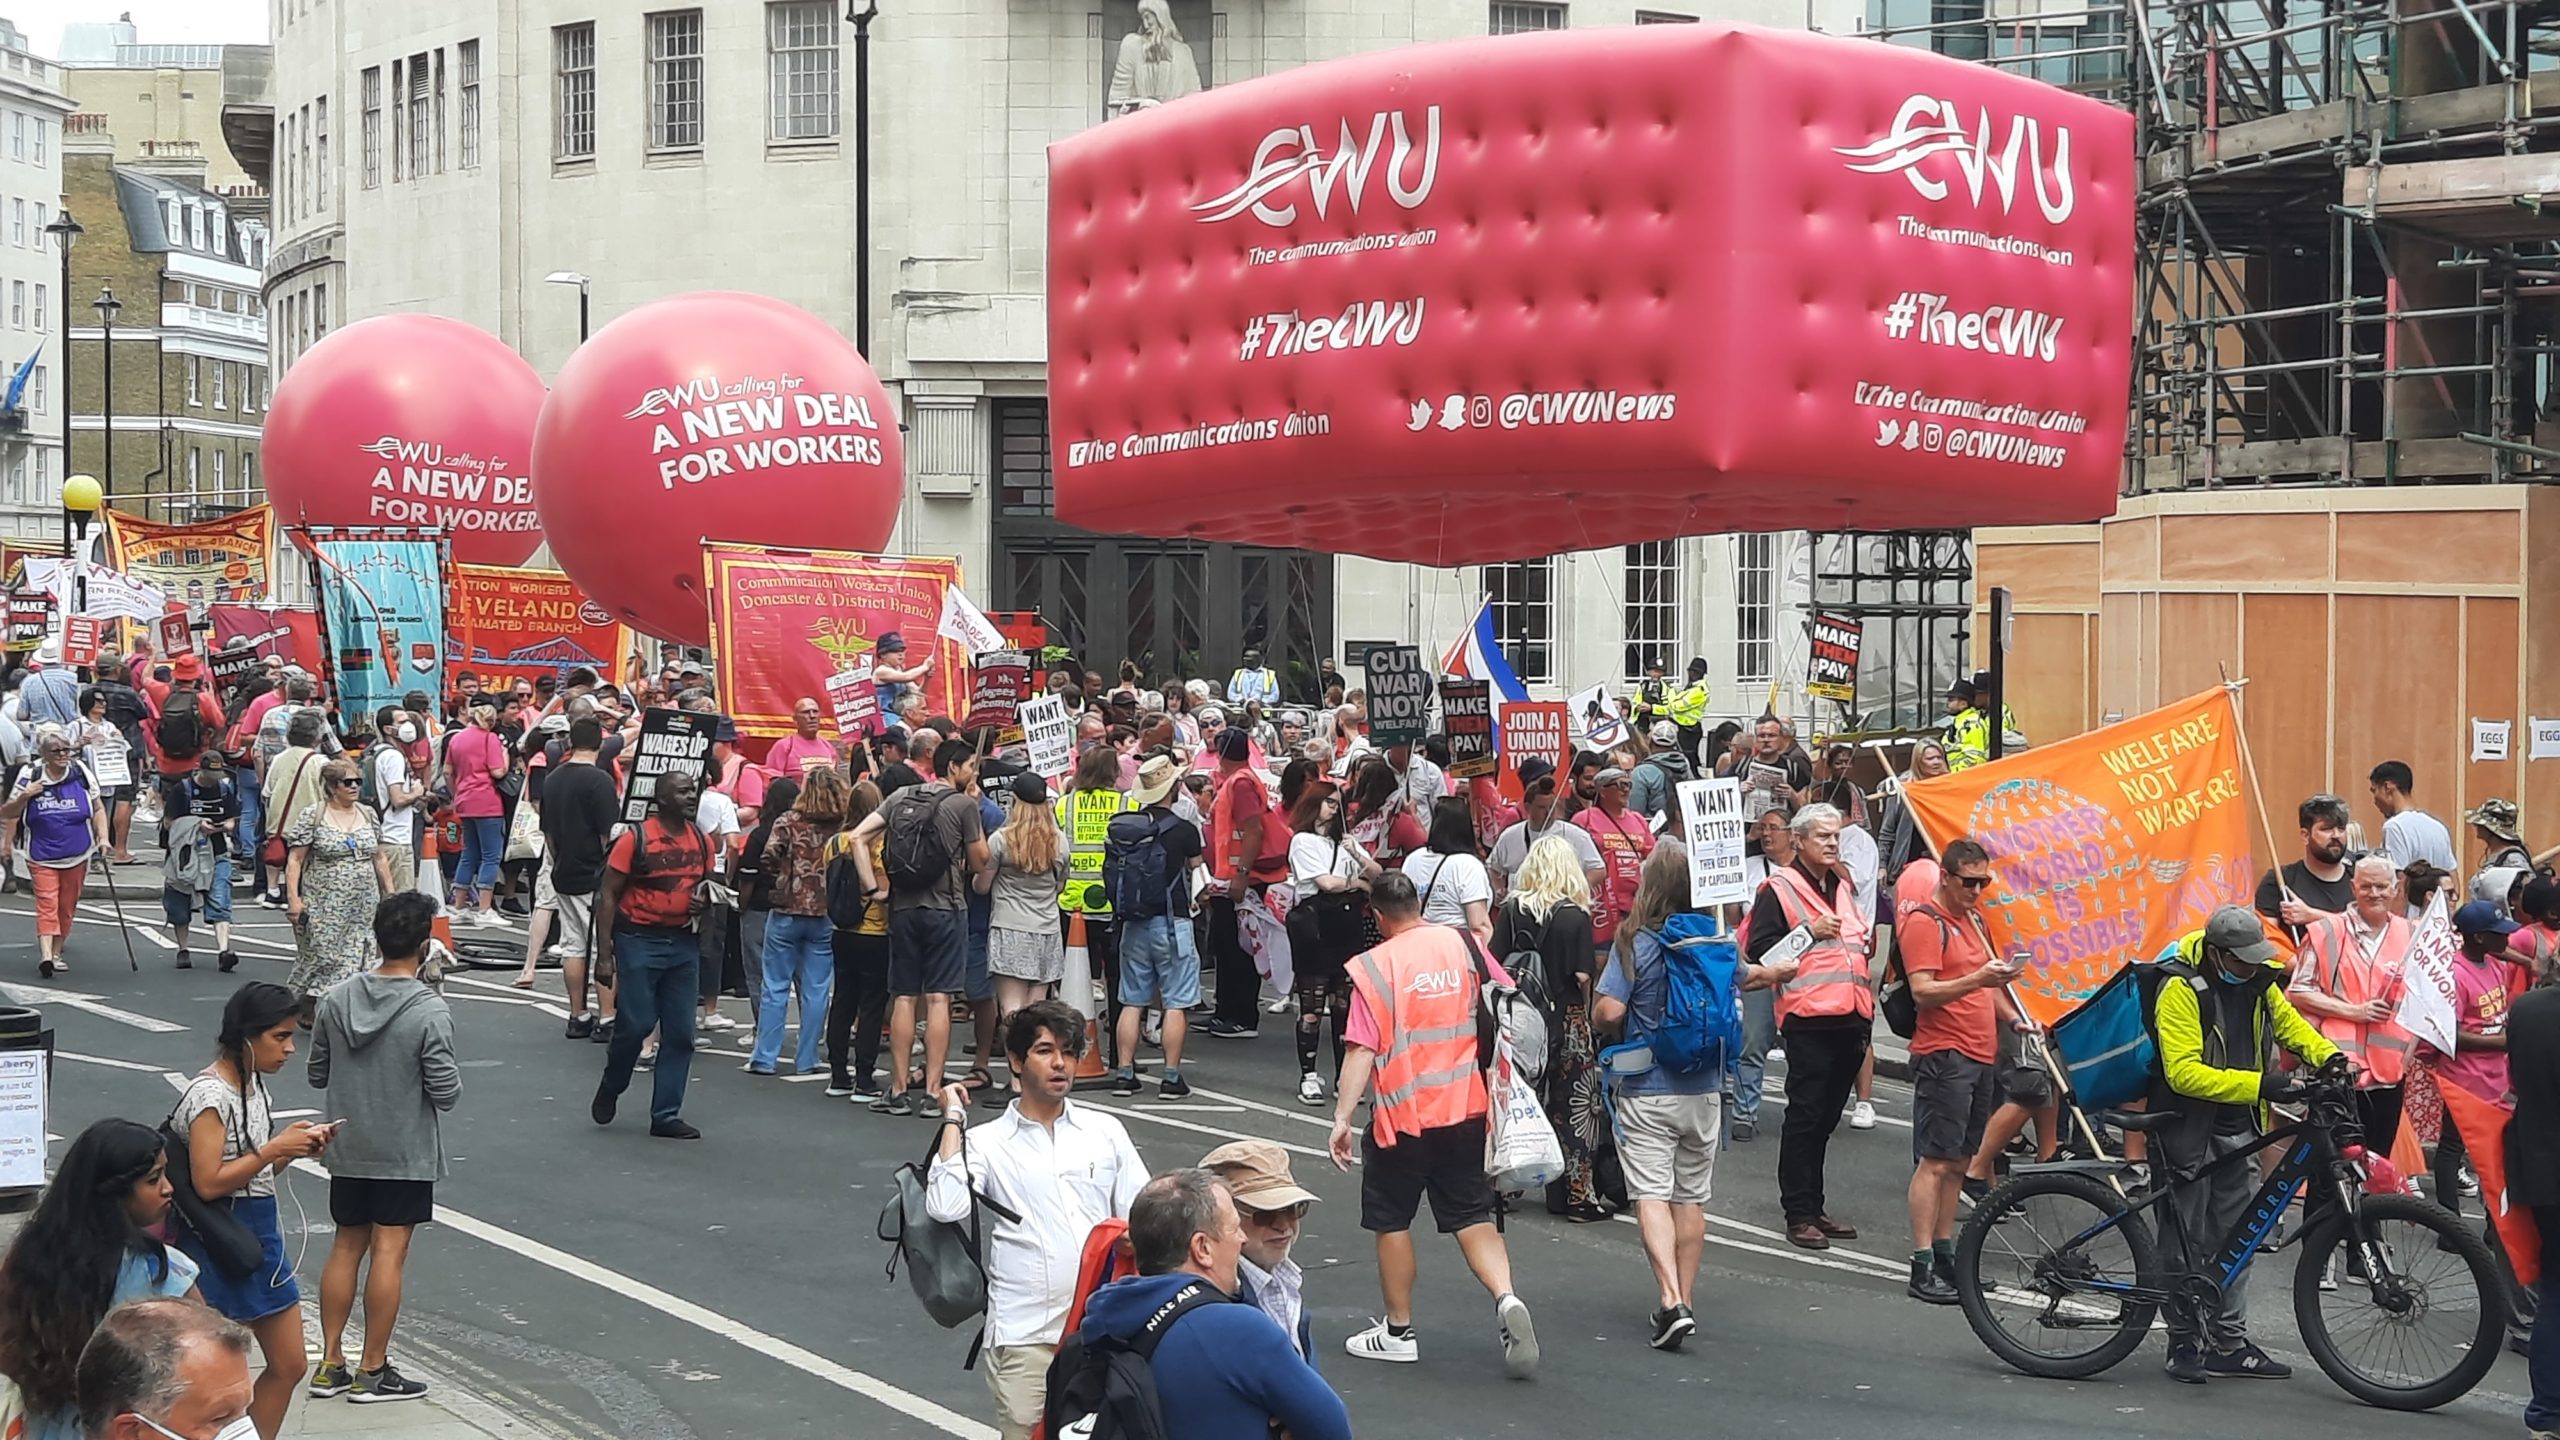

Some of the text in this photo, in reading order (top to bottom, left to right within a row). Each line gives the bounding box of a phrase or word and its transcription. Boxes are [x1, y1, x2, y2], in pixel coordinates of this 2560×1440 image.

[1189, 105, 1441, 227] CWU
[1830, 93, 2075, 224] CWU
[1898, 215, 1926, 238] The
[1249, 246, 1275, 266] The
[1239, 297, 1425, 362] #TheCWU
[1883, 291, 2065, 363] #TheCWU
[622, 372, 804, 420] CWU calling for
[1498, 390, 1676, 430] @CWUNews
[652, 393, 879, 454] A NEW DEAL
[1121, 417, 1280, 459] Communications
[1283, 411, 1330, 438] Union
[358, 436, 508, 476] CWU calling for
[1946, 428, 2067, 469] @CWUNews
[659, 434, 882, 490] FOR WORKERS
[371, 468, 395, 491] A
[402, 466, 487, 502] NEW
[370, 495, 428, 524] FOR
[509, 582, 572, 597] WORKERS
[841, 577, 894, 594] Workers
[896, 582, 932, 604] Union
[10, 601, 46, 613] MAKE
[740, 593, 934, 621] Doncaster & District Branch
[15, 624, 39, 636] PAY
[528, 623, 583, 635] BRANCH
[1814, 623, 1859, 651] MAKE
[1370, 650, 1418, 673] CUT
[1818, 658, 1848, 680] PAY
[1370, 673, 1420, 695] WAR
[1026, 701, 1060, 726] WANT
[1374, 695, 1421, 718] NOT
[1444, 697, 1488, 715] MAKE
[1028, 721, 1066, 742] BETTER?
[1505, 712, 1560, 731] JOIN A
[642, 731, 710, 758] WAGES UP
[1454, 734, 1483, 752] PAY
[1507, 732, 1560, 750] UNION
[2100, 713, 2220, 777] WELFARE
[2481, 732, 2504, 744] EGGS
[636, 755, 705, 780] BILLS DOWN
[2118, 764, 2179, 805] NOT
[38, 799, 76, 810] UNISON
[1078, 796, 1116, 811] WANT
[1693, 788, 1734, 816] WANT
[1694, 820, 1741, 842] BETTER?
[1708, 872, 1743, 886] CAPITALISM
[2002, 841, 2106, 895] WORLD
[2052, 887, 2084, 921] IS
[2421, 930, 2431, 943] A
[1402, 969, 1460, 992] CWU
[2220, 1180, 2290, 1274] ALLEGRO
[1146, 1284, 1201, 1333] NIKE AIR
